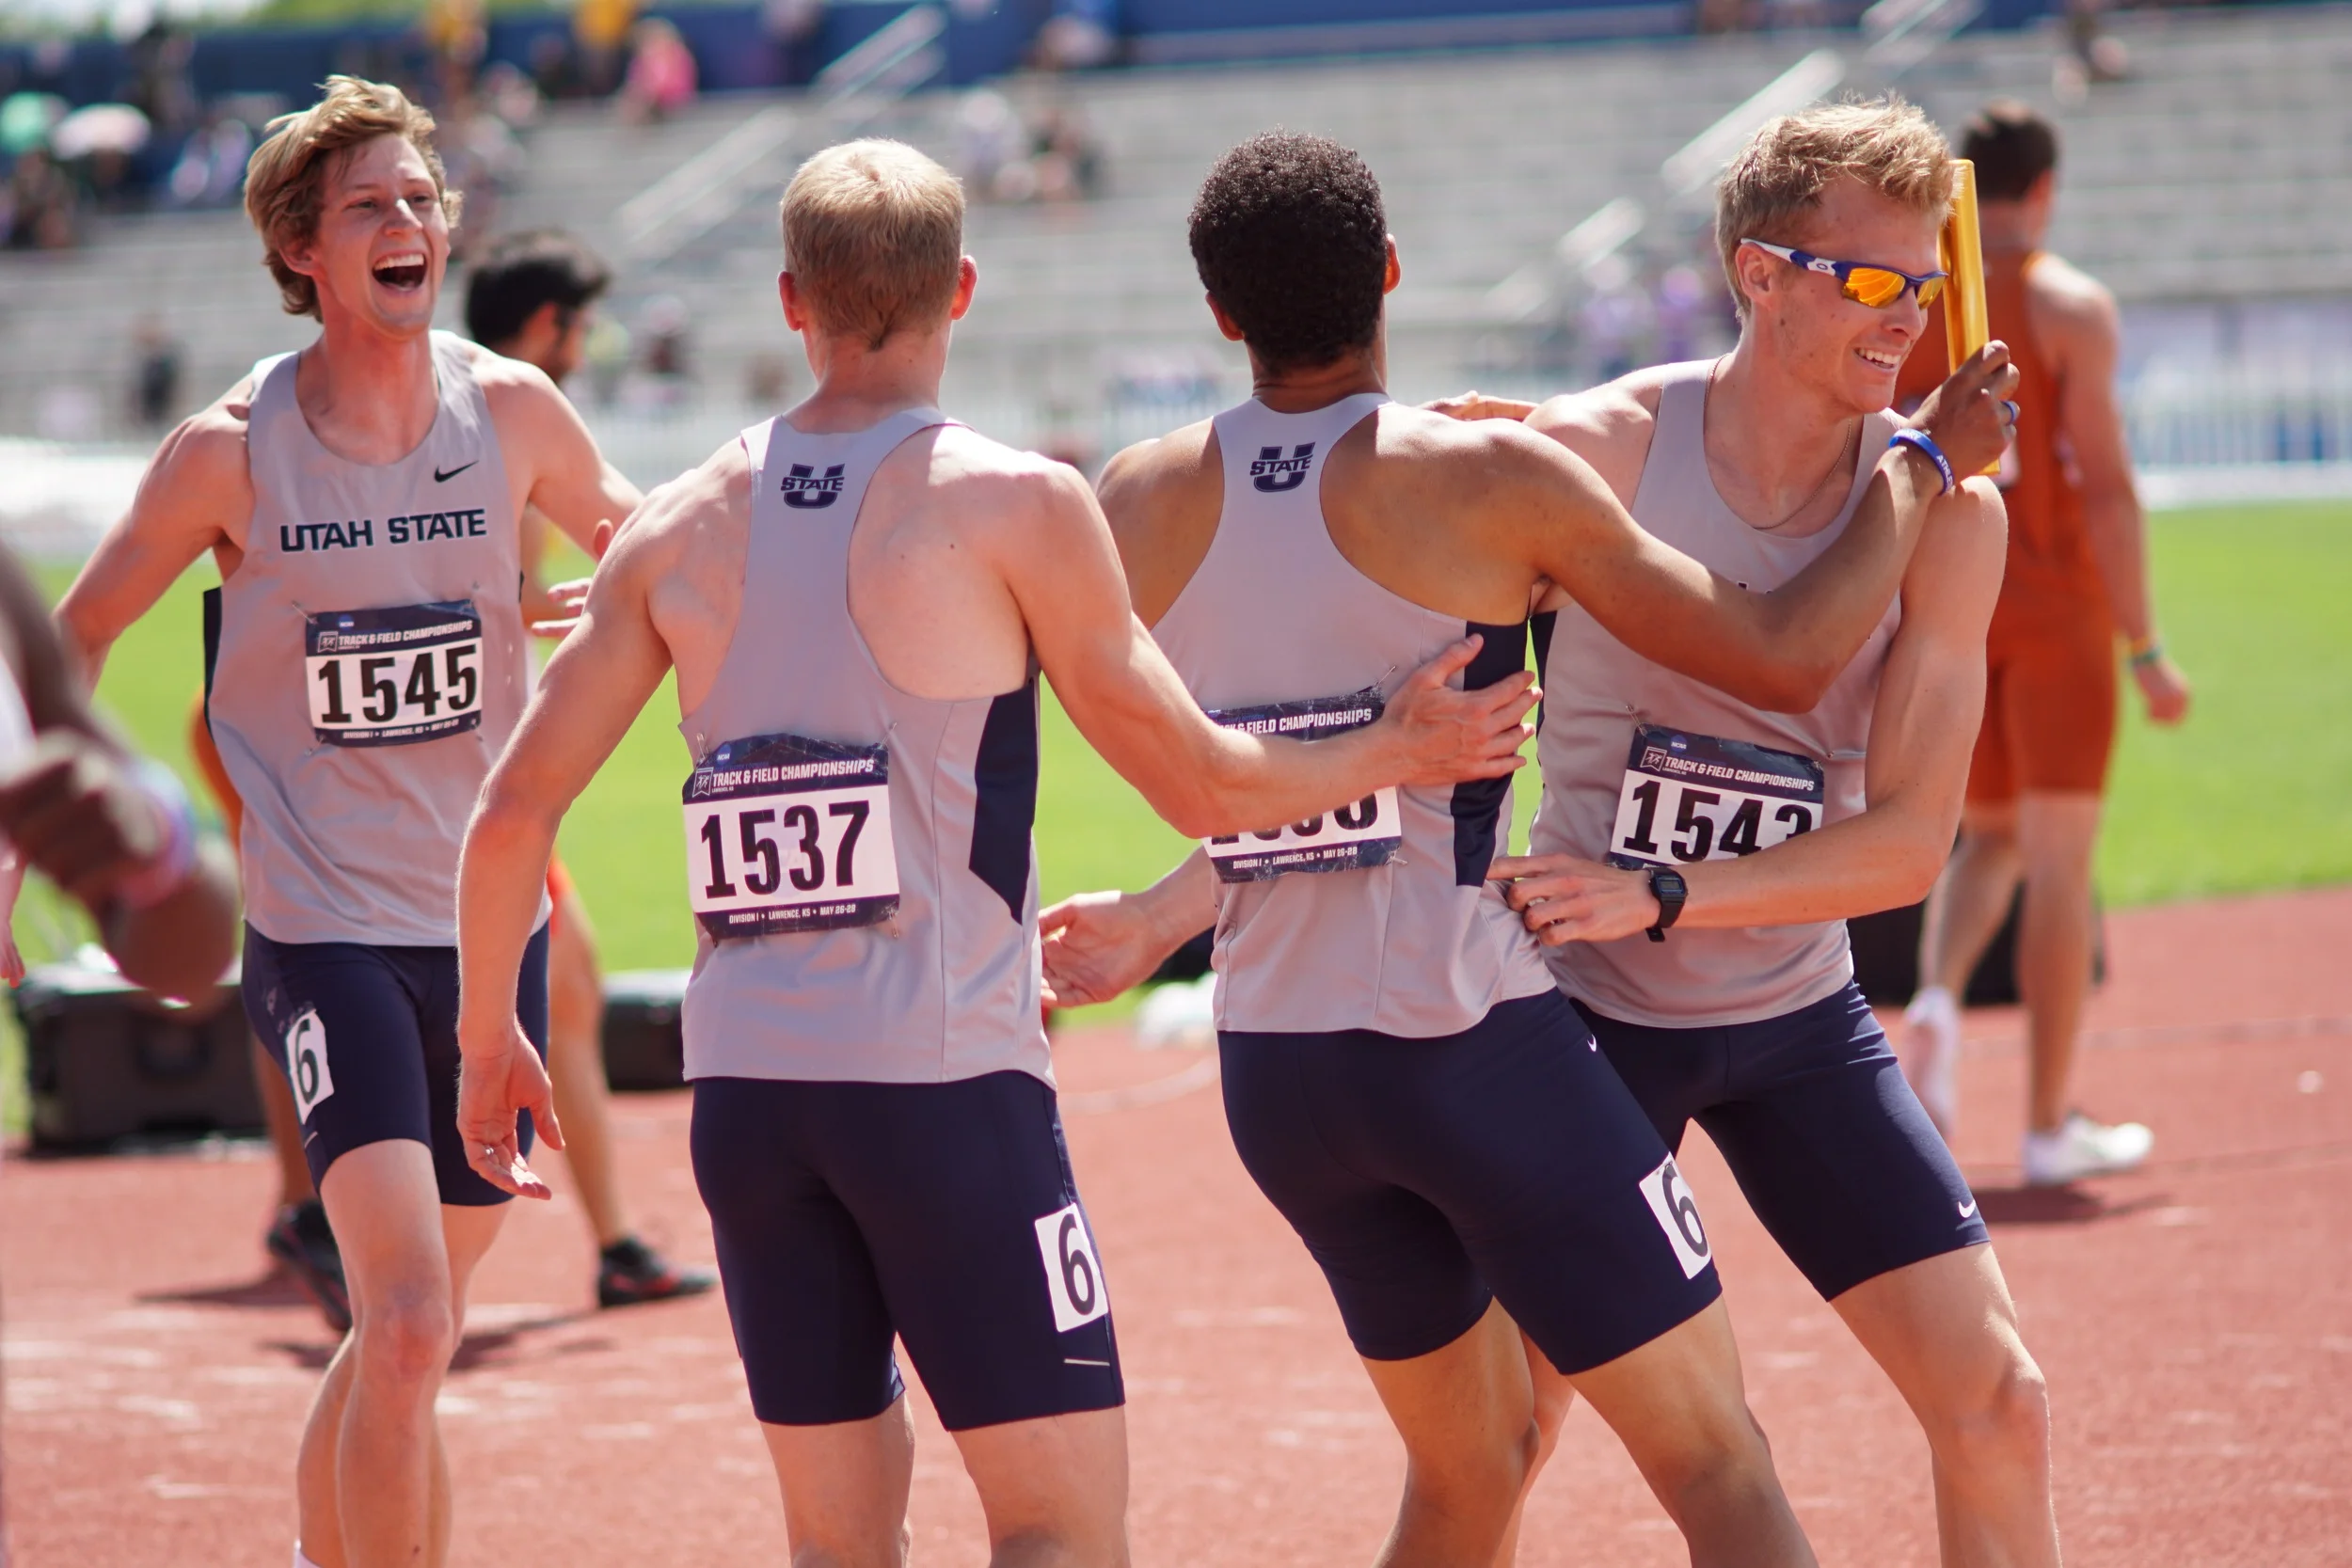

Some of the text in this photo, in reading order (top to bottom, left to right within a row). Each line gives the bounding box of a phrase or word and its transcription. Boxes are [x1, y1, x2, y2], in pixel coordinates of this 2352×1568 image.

[1249, 453, 1313, 476] STATE
[1936, 455, 1954, 487] ATHLE
[780, 476, 846, 491] STATE
[280, 508, 487, 552] UTAH STATE
[338, 632, 368, 646] TRACK
[369, 632, 376, 643] &
[376, 631, 403, 644] FIELD
[403, 620, 473, 641] CHAMPIONSHIPS
[318, 643, 477, 723] 1545
[342, 731, 370, 739] DIVISION
[1246, 719, 1277, 735] FIELD
[1279, 707, 1372, 732] CHAMPIONSHIPS
[713, 770, 742, 786] TRACK
[743, 769, 751, 784] &
[753, 767, 779, 783] FIELD
[781, 759, 875, 781] CHAMPIONSHIPS
[1664, 756, 1696, 773] TRACK
[1697, 763, 1707, 774] &
[1707, 765, 1732, 779] FIELD
[1734, 769, 1815, 791] CHAMPIONSHIPS
[701, 800, 870, 899] 1537
[1232, 858, 1258, 869] DIVISION
[1272, 853, 1306, 865] LAWRENCE,
[1306, 852, 1314, 861] KS
[1323, 849, 1336, 859] MAY
[729, 913, 755, 924] DIVISION
[769, 909, 801, 920] LAWRENCE,
[802, 908, 811, 917] KS
[819, 906, 834, 915] MAY
[834, 904, 856, 914] 26-28
[295, 1018, 319, 1105] 6
[1662, 1164, 1708, 1258] 6
[1058, 1212, 1095, 1316] 6
